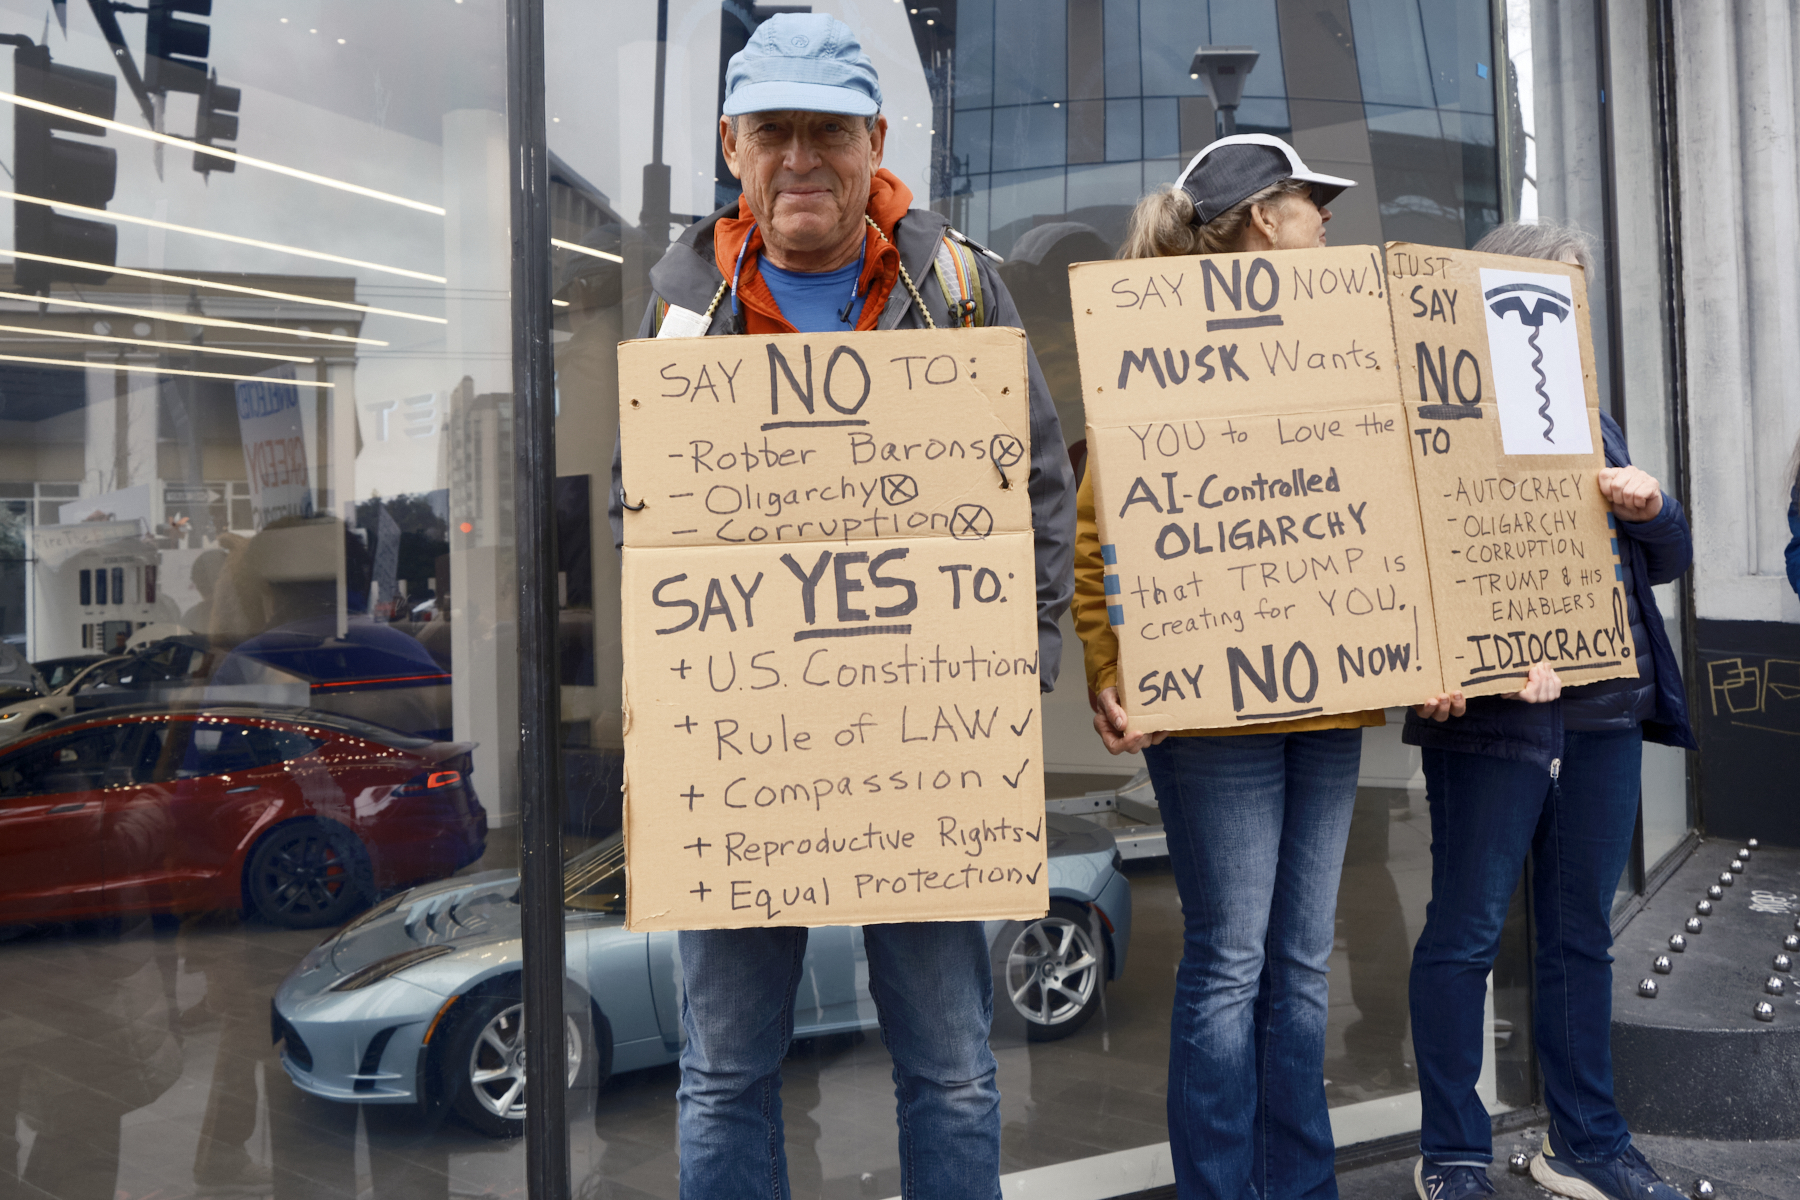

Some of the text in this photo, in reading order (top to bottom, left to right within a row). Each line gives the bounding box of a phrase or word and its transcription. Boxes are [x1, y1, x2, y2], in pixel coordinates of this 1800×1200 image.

[1111, 253, 1384, 312] SAY NO NOW!
[1393, 252, 1453, 279] JUST
[1410, 285, 1458, 325] SAY
[660, 343, 977, 415] SAY NO TO:
[1118, 340, 1378, 390] MUSK Wants
[1415, 341, 1482, 407] NO
[848, 433, 986, 464] Barons
[1128, 420, 1206, 460] YOU
[1278, 418, 1344, 445] Love
[1355, 412, 1395, 436] the
[1414, 427, 1450, 456] TO
[705, 476, 879, 517] Oligarchy
[717, 508, 949, 545] Corruption
[1155, 502, 1367, 560] OLIGARCHY
[653, 547, 1014, 635] SAY YES TO:
[1131, 571, 1203, 608] that
[1227, 548, 1364, 591] TRUMP
[1254, 598, 1296, 620] for
[1319, 585, 1406, 616] YOU.
[1492, 593, 1594, 621] ENABLERS
[708, 650, 787, 692] U.S.
[803, 644, 1029, 687] Constitution
[1139, 664, 1204, 706] SAY
[1226, 640, 1319, 712] NO
[714, 714, 811, 760] Rule
[835, 712, 878, 746] of
[901, 704, 998, 743] LAW
[724, 769, 982, 811] Compassion
[726, 822, 915, 866] Reproductive
[938, 816, 1022, 857] Rights
[731, 877, 829, 919] Equal
[854, 863, 1022, 899] Protection
